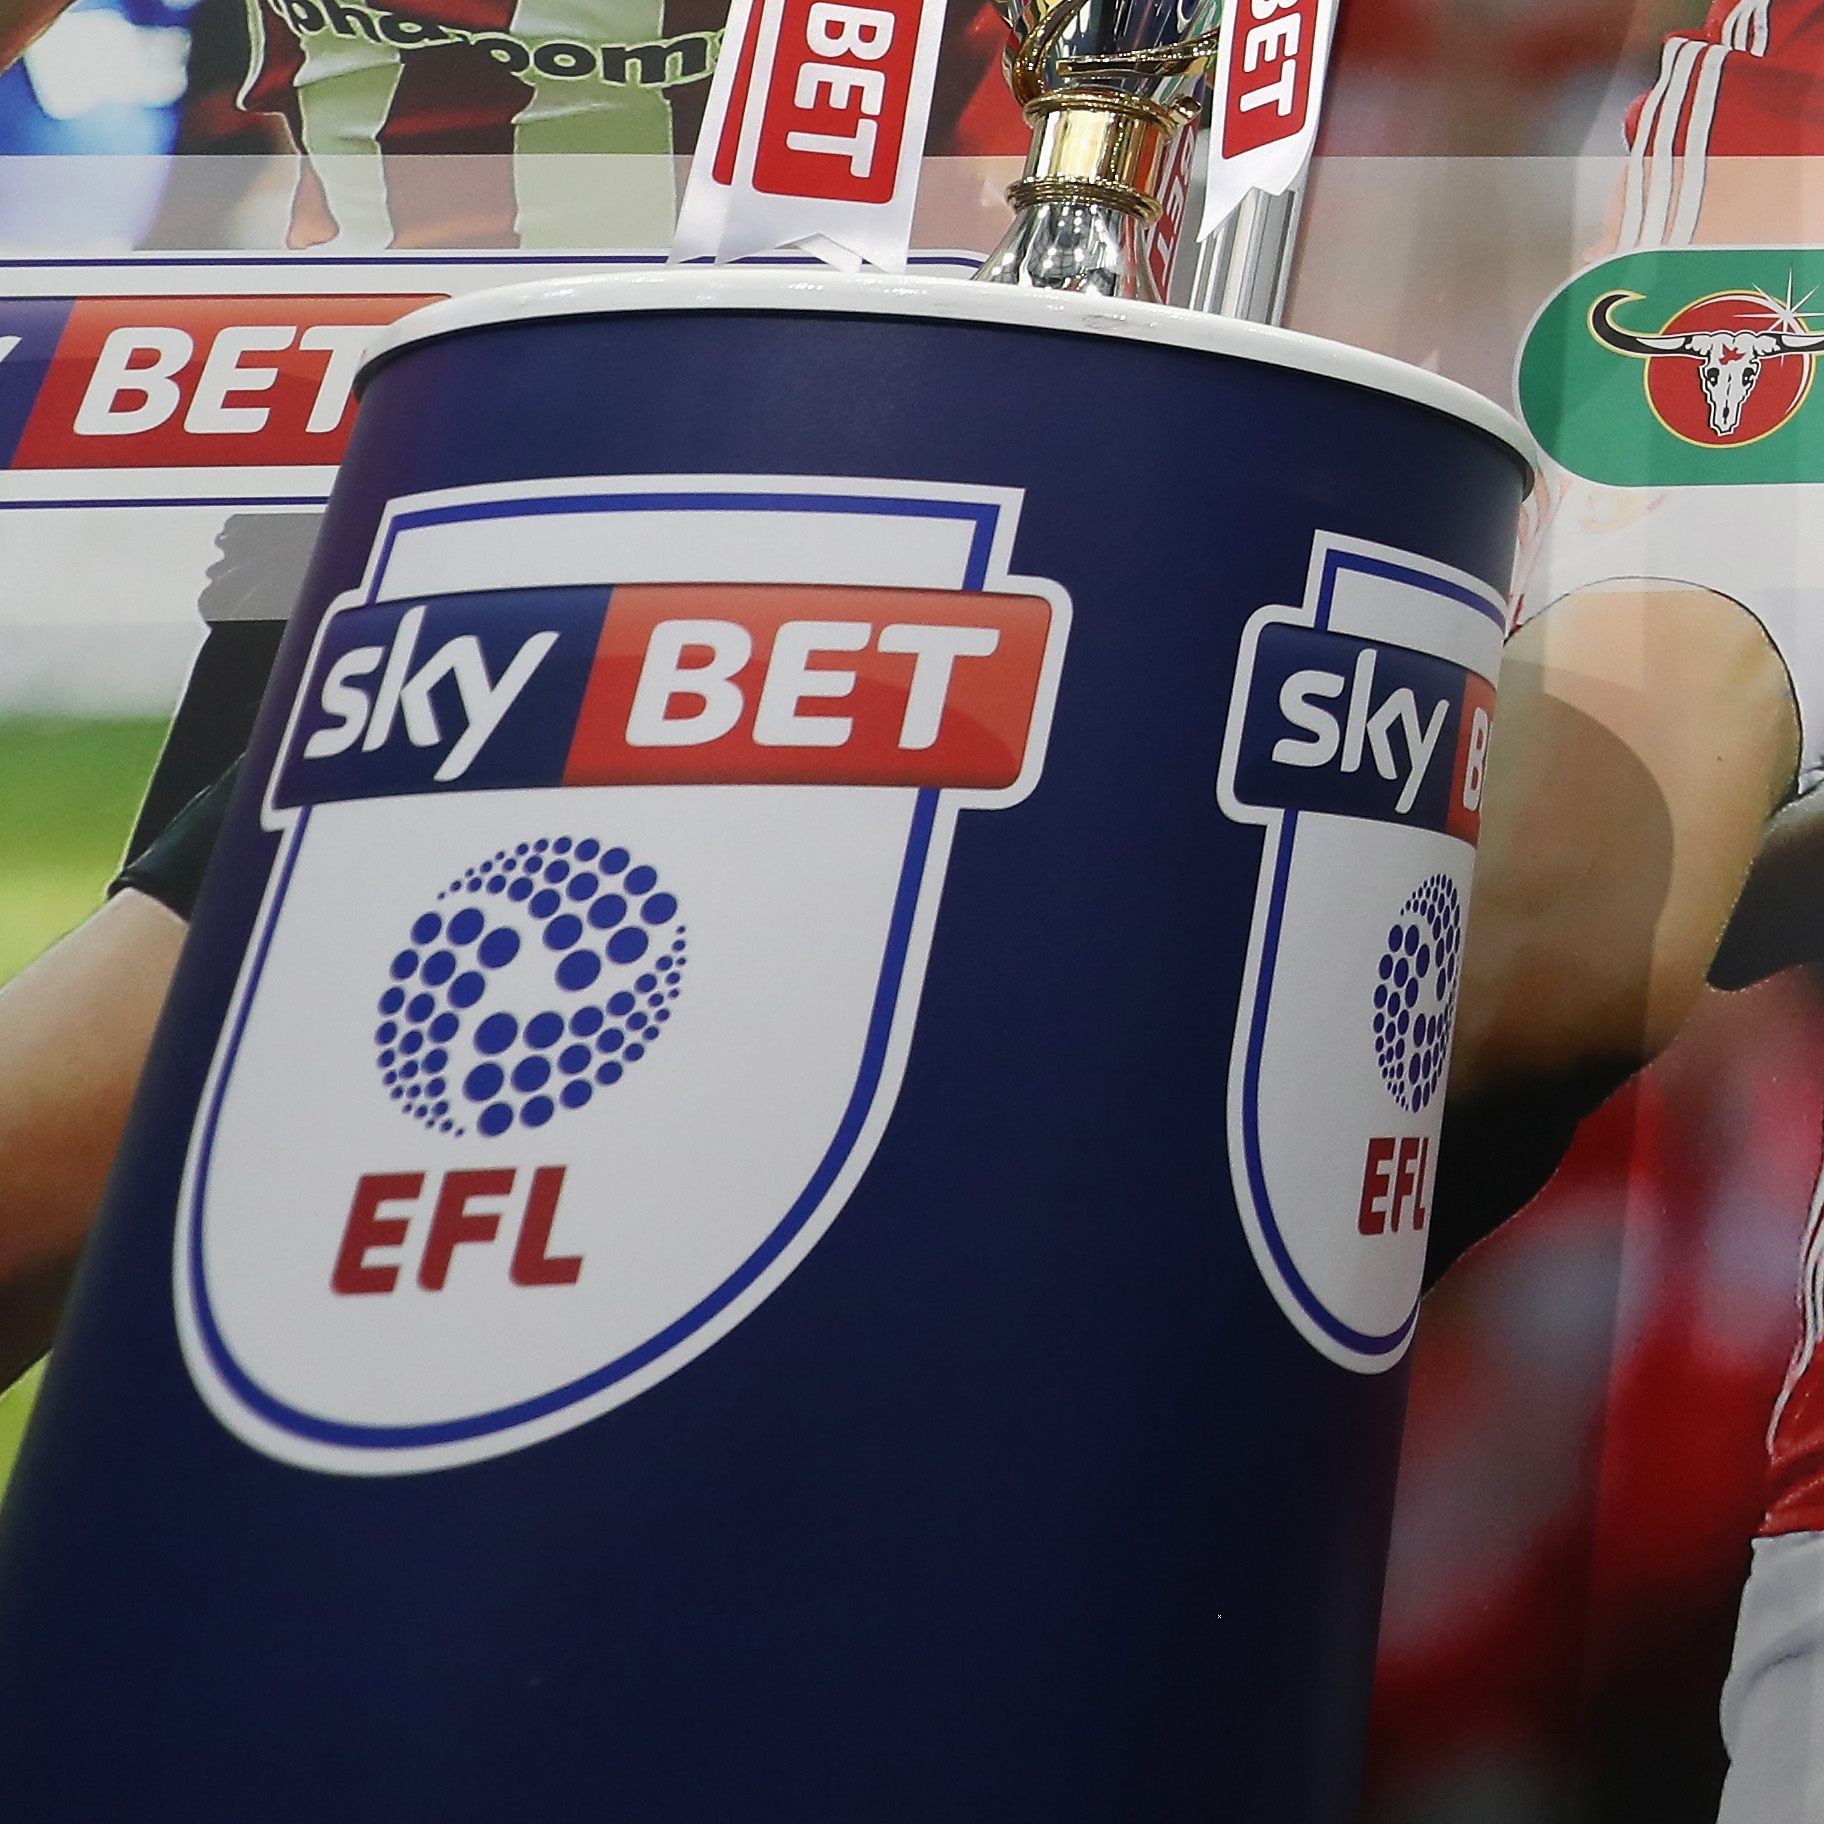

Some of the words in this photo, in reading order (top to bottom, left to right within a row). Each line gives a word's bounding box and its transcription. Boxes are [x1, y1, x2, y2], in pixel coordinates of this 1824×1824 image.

[785, 1, 896, 178] BET
[73, 326, 390, 435] BET
[303, 606, 558, 782] sky
[624, 619, 1000, 751] BET
[1271, 647, 1450, 814] sky
[330, 1166, 584, 1296] EFL
